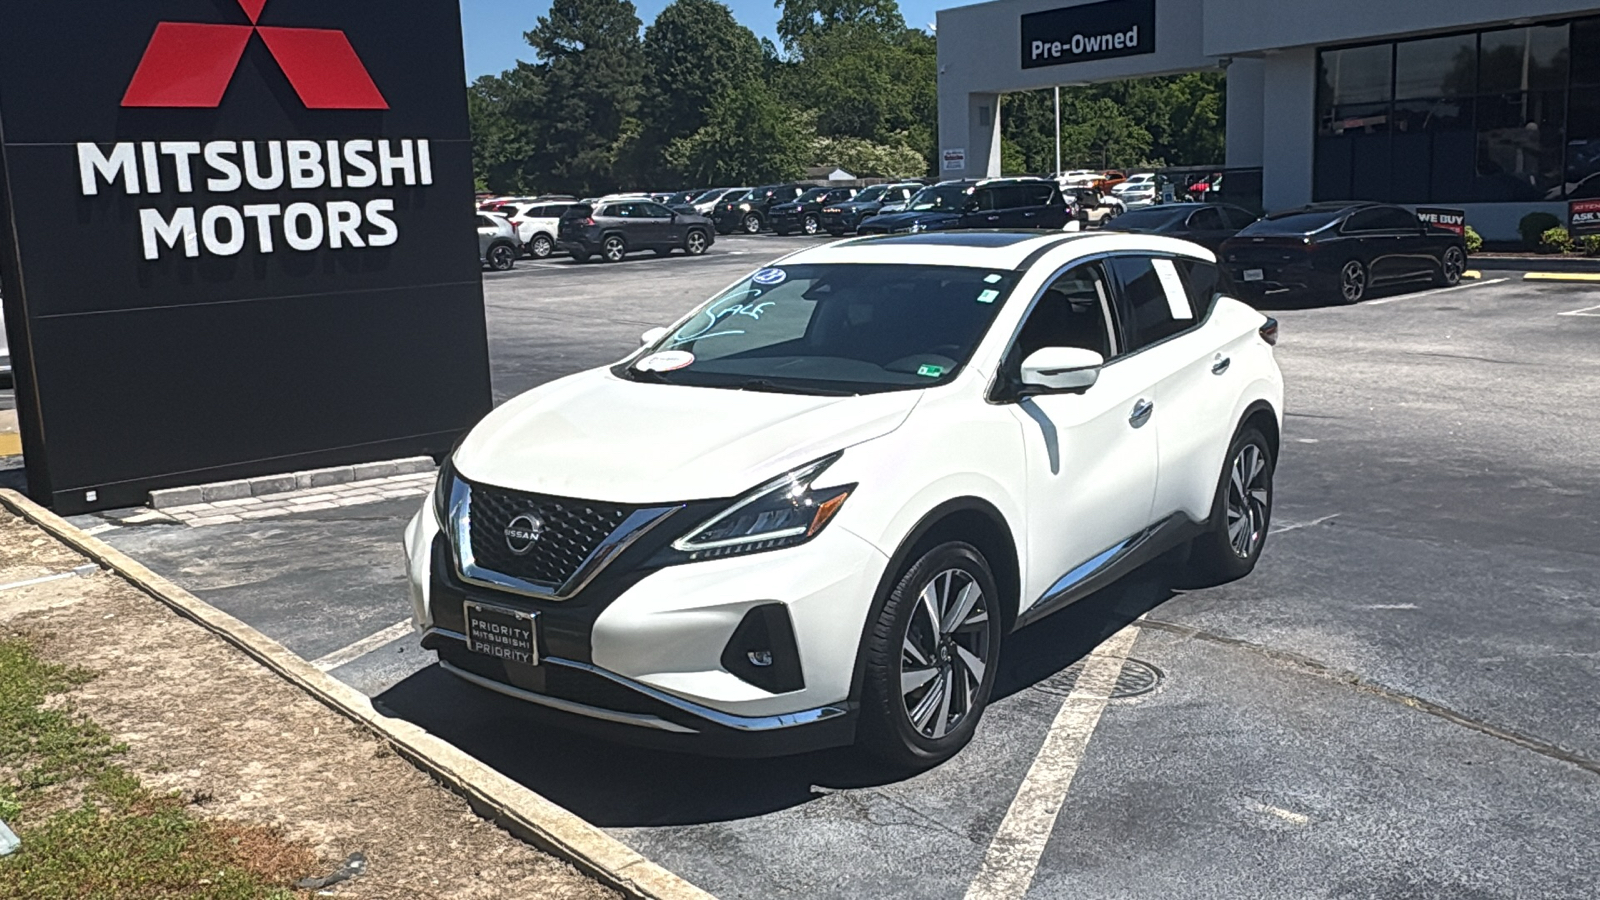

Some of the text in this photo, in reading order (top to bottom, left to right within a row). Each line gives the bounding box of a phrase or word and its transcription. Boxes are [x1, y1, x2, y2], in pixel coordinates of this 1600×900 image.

[1031, 25, 1138, 60] Pre-Owned
[76, 139, 433, 196] MITSUBISHI
[1417, 213, 1464, 225] WE BUY
[1572, 213, 1594, 222] ASK
[139, 198, 399, 260] MOTORS
[471, 618, 530, 640] PRIORITY
[472, 629, 530, 649] MITSUBISHI
[475, 642, 529, 662] PRIORITY
